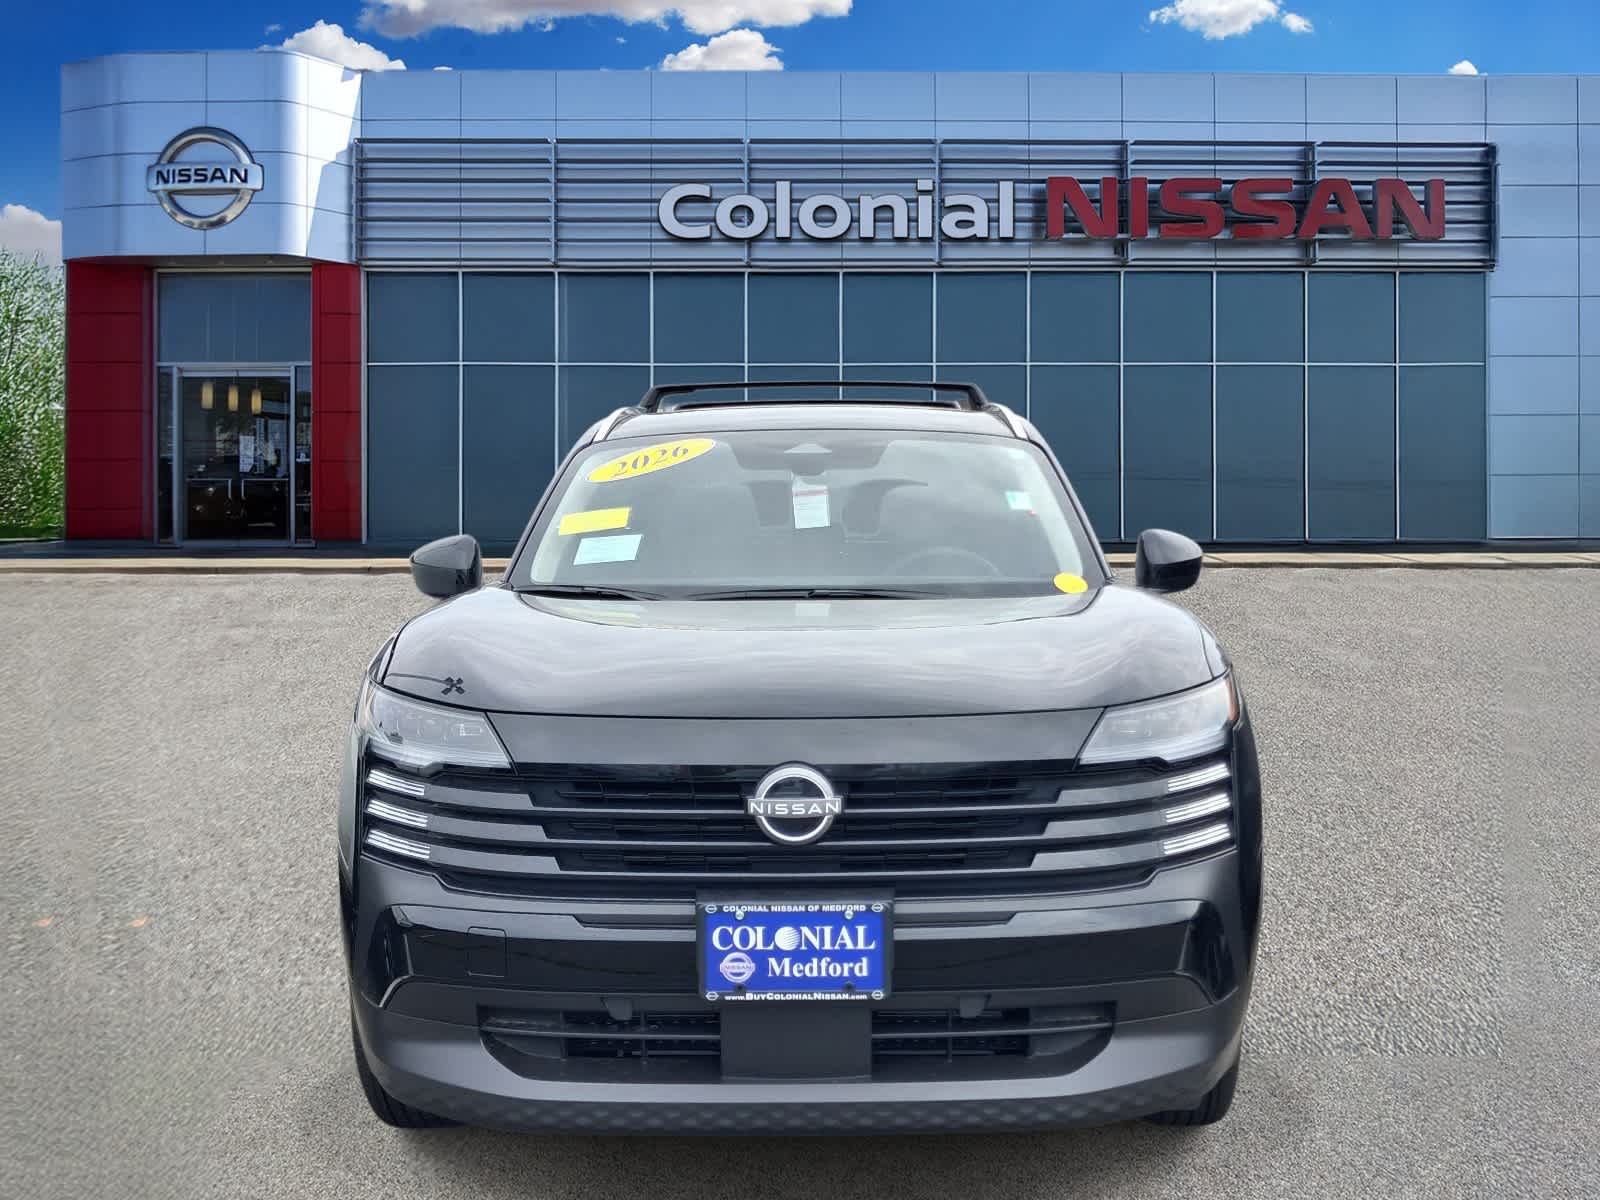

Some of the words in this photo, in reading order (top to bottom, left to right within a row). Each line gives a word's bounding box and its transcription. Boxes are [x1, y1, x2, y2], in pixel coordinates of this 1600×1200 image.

[155, 167, 248, 185] NISSAN
[657, 180, 1015, 240] Colonial
[1045, 176, 1446, 240] NISSAN
[612, 446, 689, 476] 2026
[750, 802, 839, 815] NISSAN
[722, 904, 769, 913] COLONIAL
[770, 904, 806, 913] NISSAN
[807, 904, 820, 913] OF
[821, 903, 867, 912] MEDFORD
[767, 956, 869, 978] Medford
